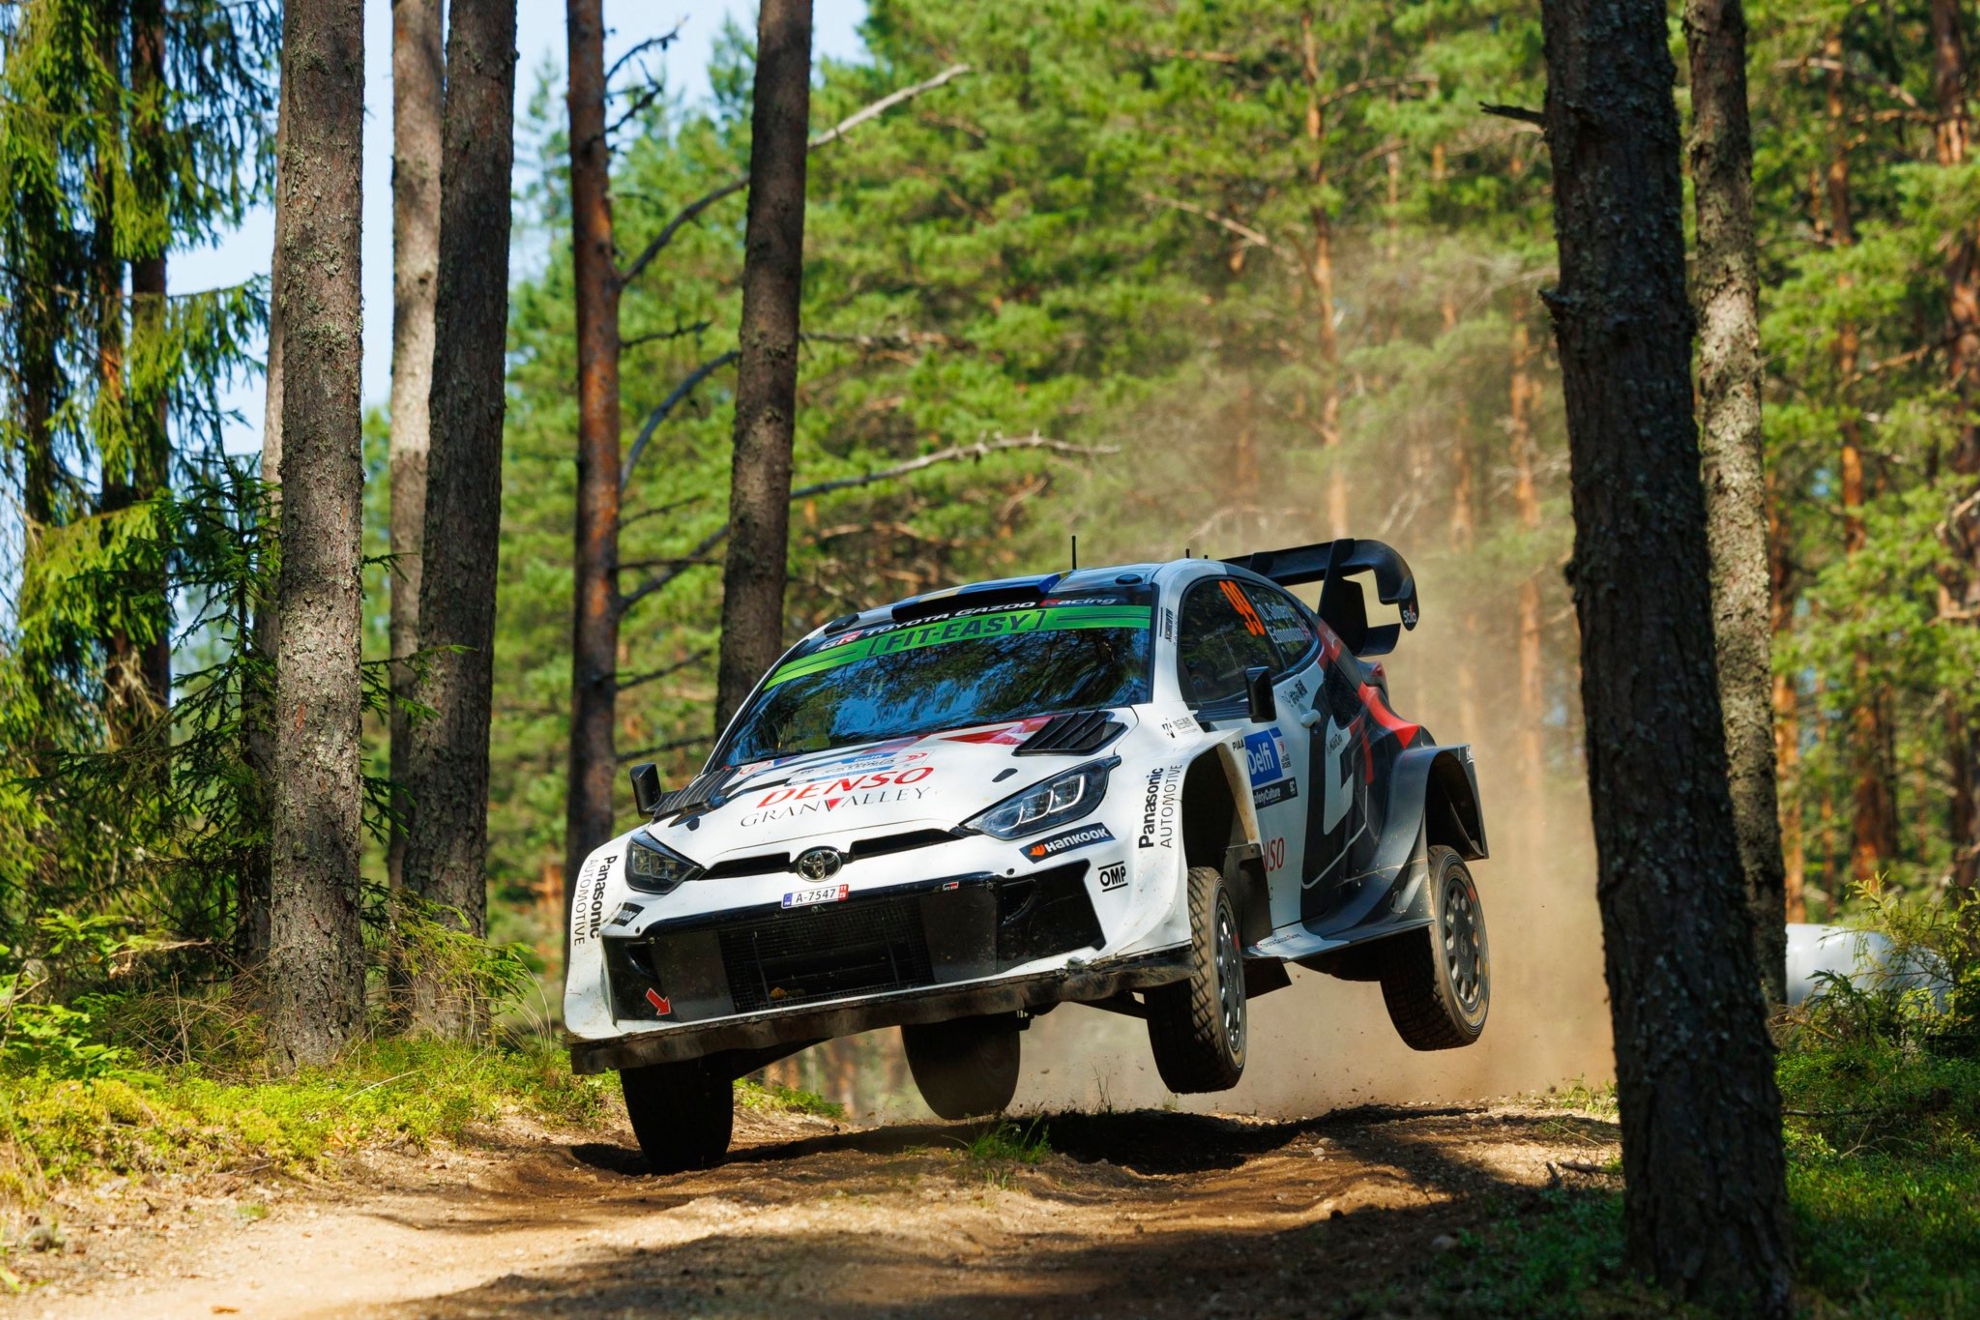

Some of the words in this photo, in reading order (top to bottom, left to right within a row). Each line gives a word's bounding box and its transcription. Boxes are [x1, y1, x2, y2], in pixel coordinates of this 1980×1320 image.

[866, 613, 949, 636] TOYOTA
[954, 600, 1036, 618] GAZOO
[1039, 597, 1117, 607] Racing
[1218, 579, 1266, 636] 99
[1232, 739, 1245, 751] PIAA
[1246, 742, 1275, 776] Delfi
[756, 766, 934, 808] DENSO
[1160, 764, 1183, 849] AUTOMOTIVE
[1254, 786, 1281, 805] afetyCulture
[1138, 767, 1164, 849] Panasonic
[1263, 837, 1285, 872] NSO
[795, 888, 837, 903] A-7547
[1100, 864, 1127, 888] OMP
[574, 859, 599, 946] AUTOMOTIVE
[589, 855, 618, 940] Panasonic
